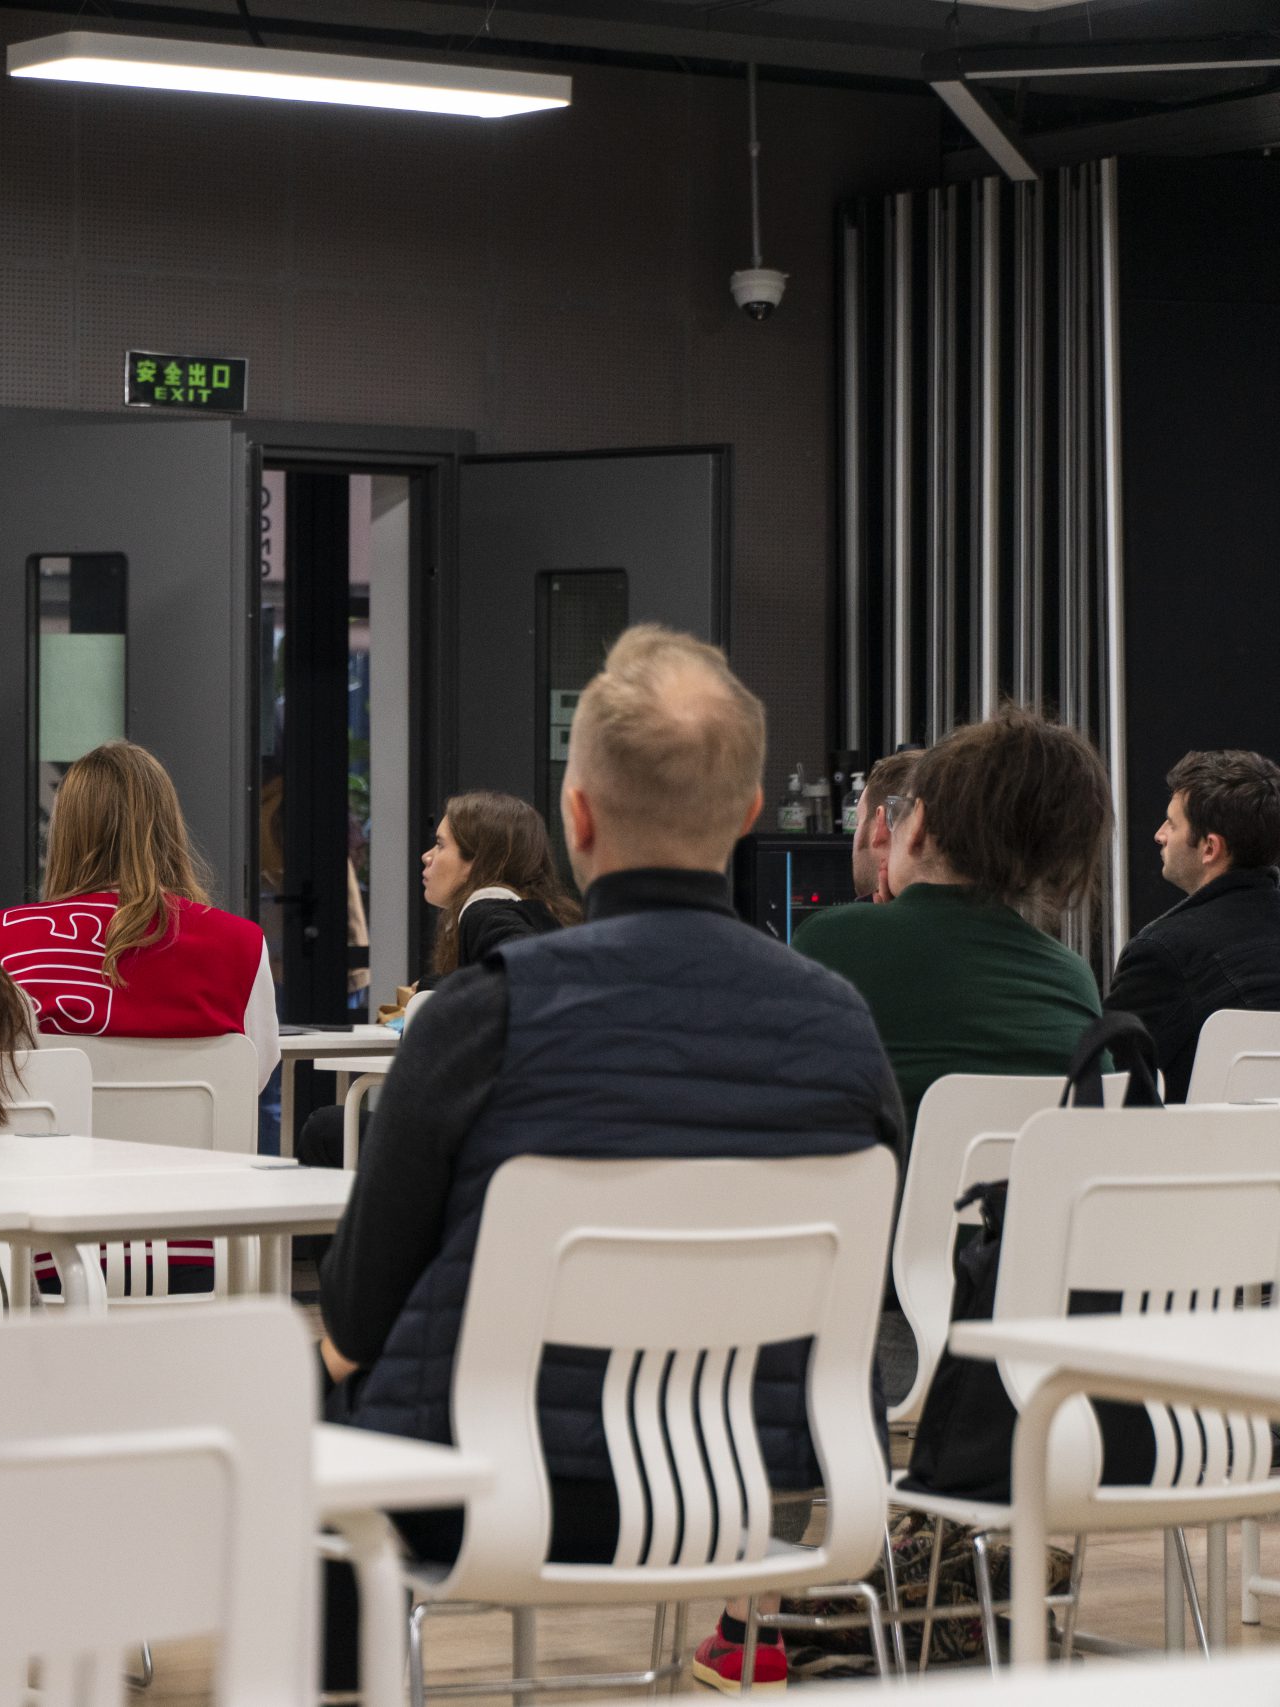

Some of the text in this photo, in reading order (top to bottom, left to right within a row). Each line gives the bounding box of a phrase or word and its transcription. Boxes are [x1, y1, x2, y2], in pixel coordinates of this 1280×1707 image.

[136, 360, 230, 388] 安全出口
[154, 387, 211, 402] EXIT
